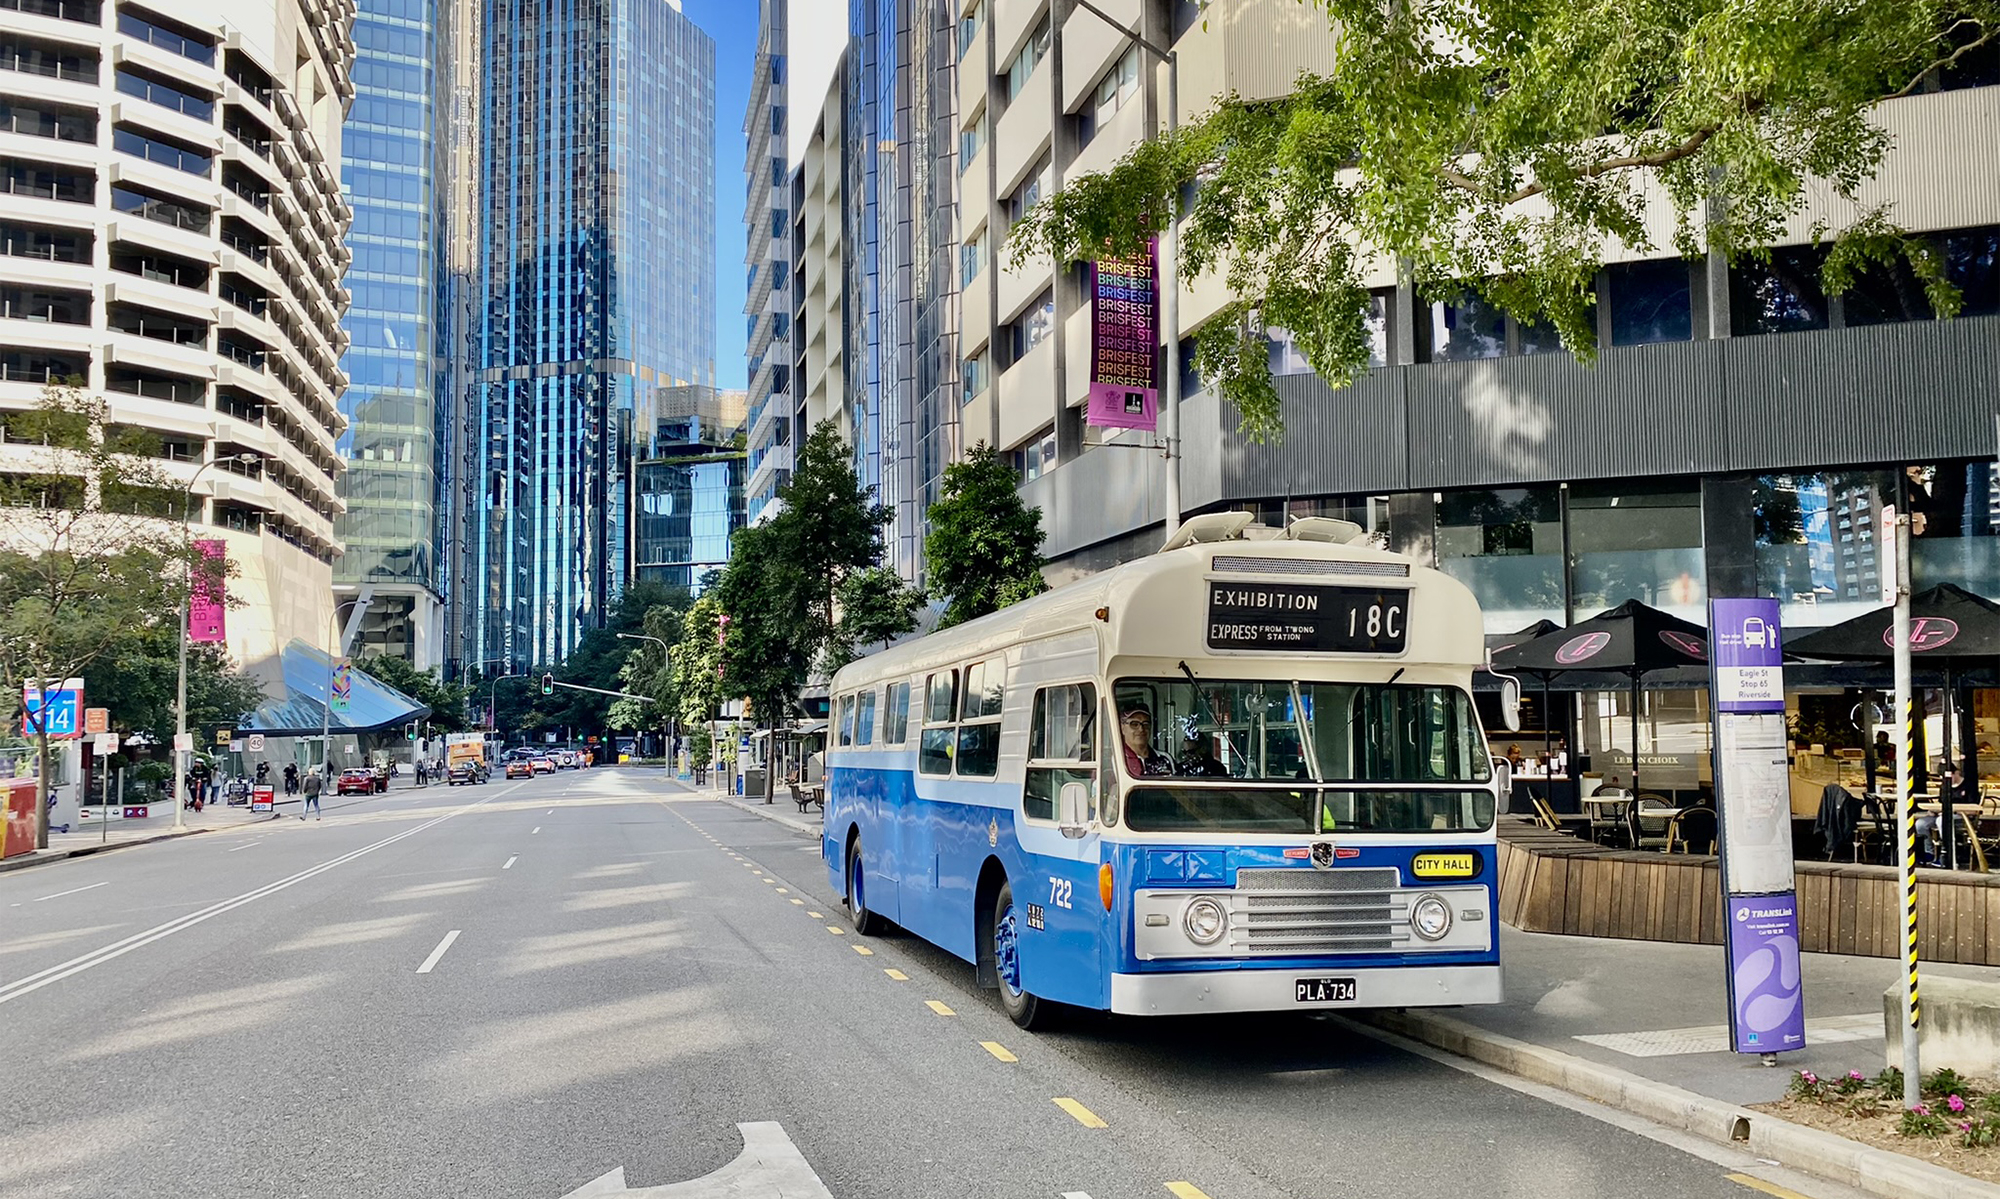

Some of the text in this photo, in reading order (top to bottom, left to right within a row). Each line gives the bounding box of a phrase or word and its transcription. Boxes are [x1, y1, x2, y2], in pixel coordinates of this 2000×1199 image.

[1098, 260, 1153, 278] BRISFEST
[1098, 273, 1153, 290] BRISFEST
[1098, 286, 1153, 302] BRISFEST
[1098, 298, 1152, 316] BRISFEST
[1098, 310, 1152, 328] BRISFEST
[1098, 323, 1152, 340] BRISFEST
[1098, 336, 1152, 352] BRISFEST
[1098, 348, 1152, 366] BRISFEST
[1098, 362, 1152, 378] BRISFEST
[1214, 590, 1318, 610] EXHIBITION
[1211, 624, 1258, 640] EXPRESS
[1260, 625, 1282, 633] FROM
[1740, 670, 1760, 678] Eagle
[1740, 680, 1758, 688] Stop
[1416, 860, 1470, 870] CITY HALL
[1049, 876, 1072, 910] 722
